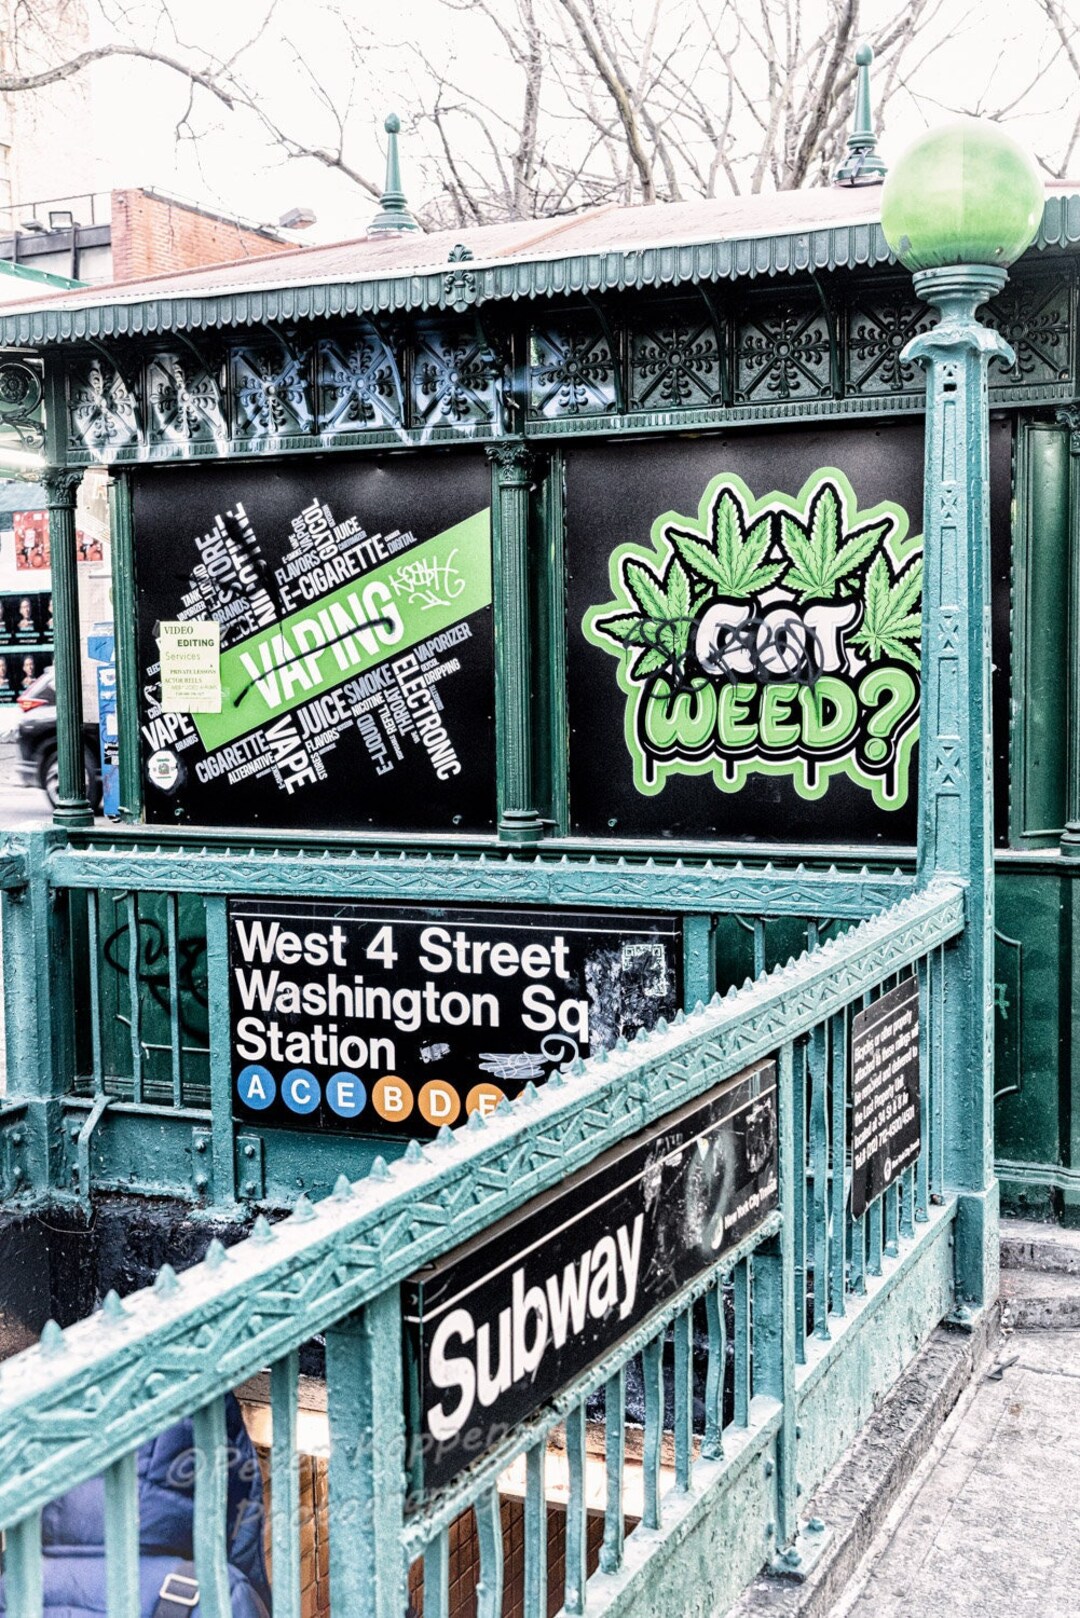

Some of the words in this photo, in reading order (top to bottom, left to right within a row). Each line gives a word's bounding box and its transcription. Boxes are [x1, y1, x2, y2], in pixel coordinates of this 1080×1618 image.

[291, 515, 314, 552] VAPOR
[302, 497, 338, 560] GLYCOL
[333, 516, 362, 542] JUICE
[387, 531, 418, 555] DIGITAL
[274, 550, 320, 586] FLAVORS
[279, 533, 389, 611] E-CIGARETTE
[180, 588, 202, 608] TANK
[212, 596, 250, 622] BRANDS
[164, 626, 194, 635] VIDEO
[178, 639, 214, 647] EDITING
[239, 581, 405, 710] VAPING
[414, 622, 472, 662] VAPORIZER
[696, 603, 856, 676] GOT
[165, 651, 200, 661] Services
[424, 658, 461, 684] DRIPPING
[344, 663, 395, 704] SMOKE
[296, 688, 352, 740] JUICE
[351, 692, 385, 717] NICOTINE
[378, 704, 397, 735] REFILL
[384, 686, 414, 736] THROAT
[392, 653, 462, 780] ELECTRONIC
[644, 667, 917, 761] WEED?
[142, 712, 194, 751] VAPE
[174, 734, 198, 752] BRANDS
[305, 728, 340, 753] FLAVORS
[357, 714, 394, 776] E-LIQUID
[195, 730, 270, 783] CIGARETTE
[228, 752, 275, 785] ALTERNATIVE
[264, 714, 317, 794] VAPE
[310, 752, 328, 780] STORES
[234, 919, 347, 966] West
[366, 925, 398, 969] 4
[418, 925, 570, 979] Street
[234, 968, 500, 1032] Washington
[521, 984, 589, 1043] Sq
[236, 1016, 396, 1071] Station
[246, 1074, 266, 1100] A
[290, 1079, 312, 1104] C
[339, 1082, 356, 1108] E
[385, 1086, 402, 1112] B
[431, 1090, 450, 1118] D
[427, 1213, 644, 1442] Subway
